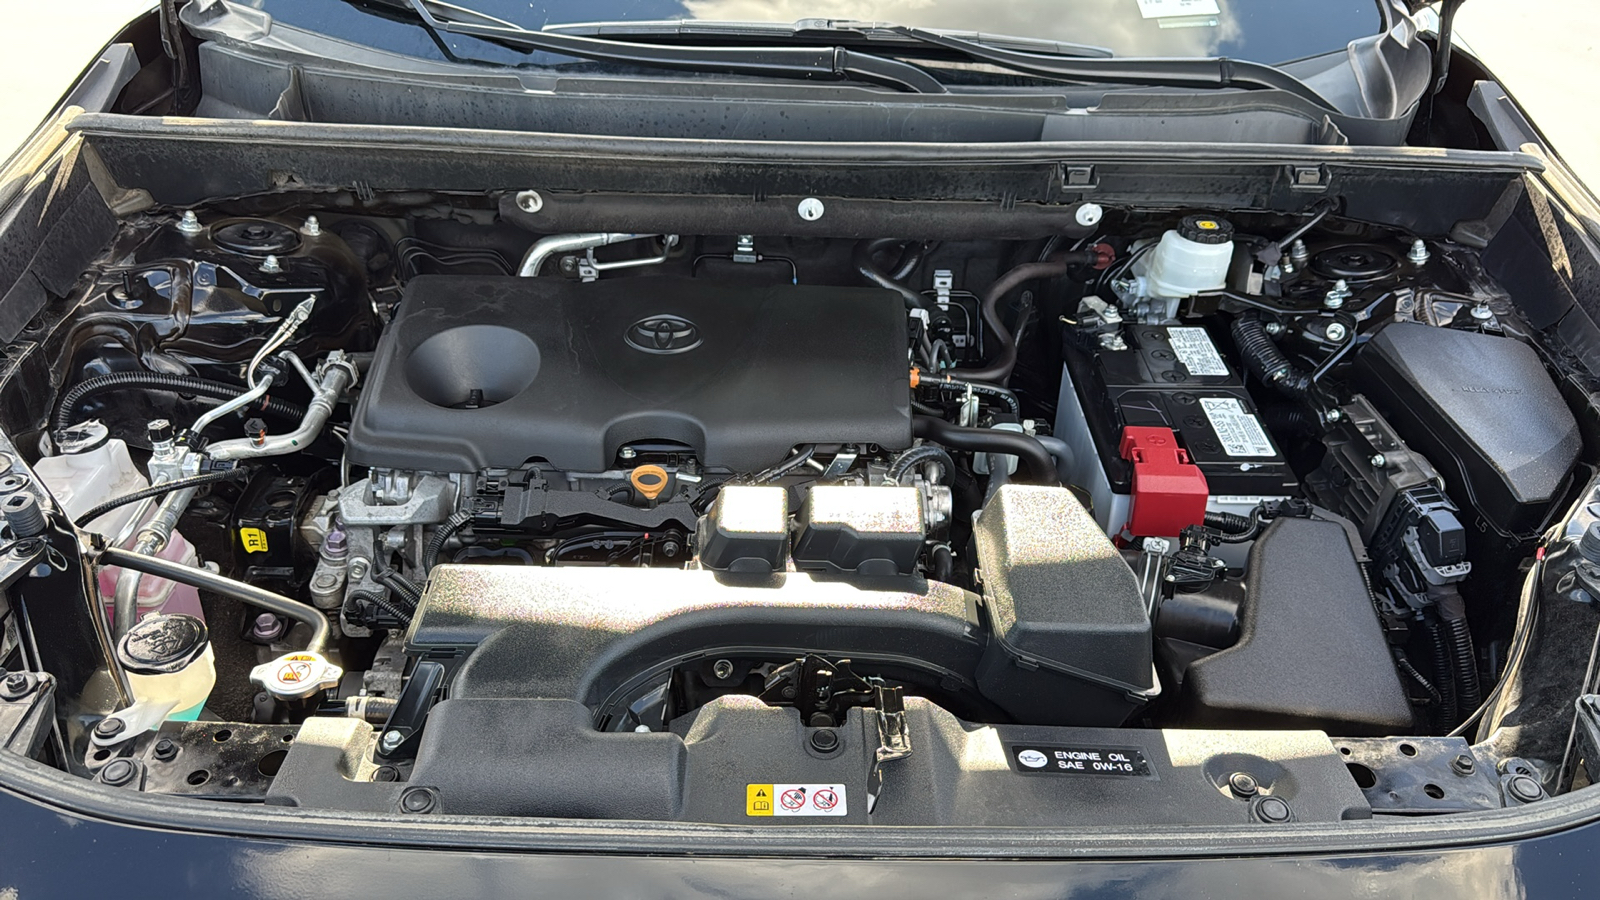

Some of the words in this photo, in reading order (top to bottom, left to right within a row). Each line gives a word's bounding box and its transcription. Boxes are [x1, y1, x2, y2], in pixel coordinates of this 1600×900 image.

[247, 533, 259, 547] R1
[1054, 751, 1102, 761] ENGINE
[1108, 753, 1130, 762] OIL
[1057, 761, 1085, 769] SAE
[1092, 762, 1133, 772] 0W-16
